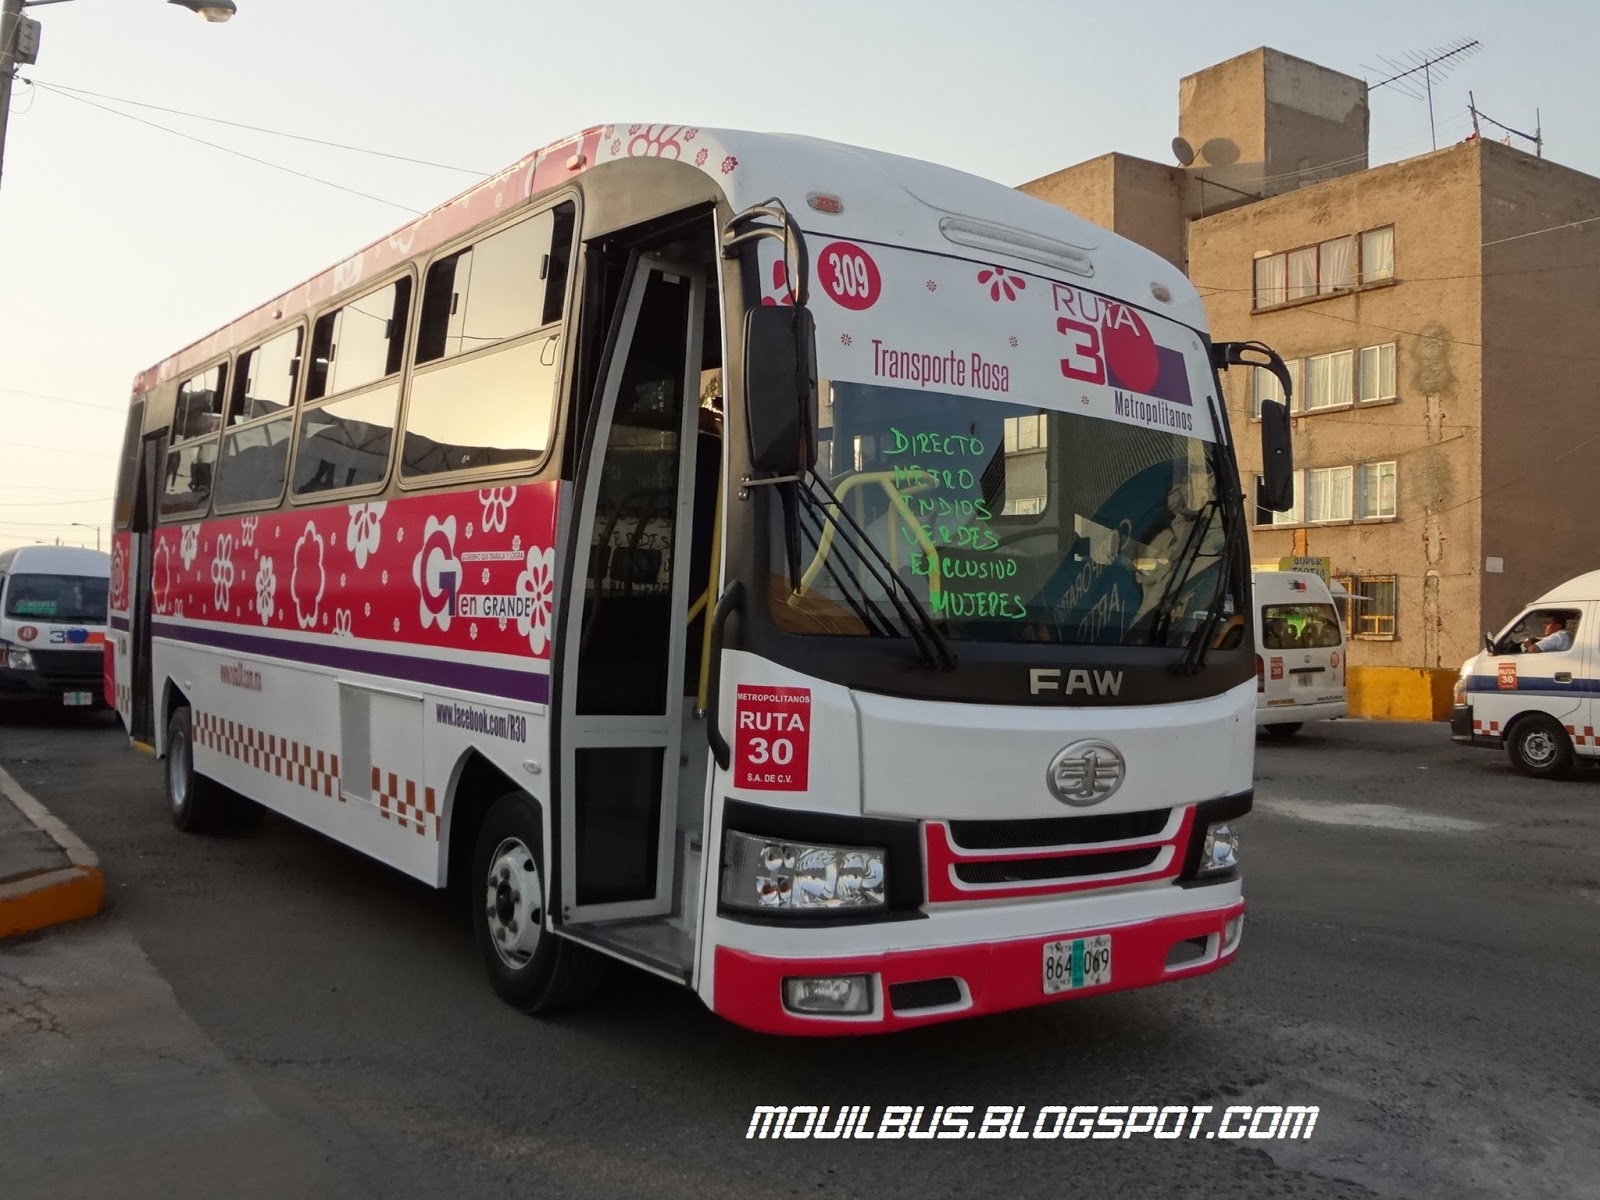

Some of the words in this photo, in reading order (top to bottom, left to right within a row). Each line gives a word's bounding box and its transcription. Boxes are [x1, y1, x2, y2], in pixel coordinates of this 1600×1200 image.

[828, 252, 869, 299] 309
[1051, 283, 1141, 337] RUTA
[871, 339, 966, 387] Transporte
[971, 353, 1010, 393] Rosa
[1114, 390, 1193, 432] Metropolitanos
[883, 427, 985, 457] DIRECTO
[893, 464, 974, 490] METRO
[899, 495, 992, 521] INDIOS
[901, 525, 999, 550] VERDES
[1293, 557, 1323, 566] SUPER
[460, 596, 477, 615] en
[482, 596, 530, 617] GRANDE
[931, 590, 1027, 619] MUJERES
[1029, 668, 1124, 696] FAW
[1501, 675, 1514, 684] 30
[736, 692, 811, 704] METROPOLITANOS
[435, 702, 528, 744] www.facebook.com/R30
[739, 710, 805, 732] RUTA
[747, 737, 794, 765] 30
[747, 773, 763, 782] S.A.
[764, 774, 776, 783] DE
[777, 774, 793, 783] C.V.
[1046, 953, 1072, 981] 864
[1083, 948, 1110, 975] 069
